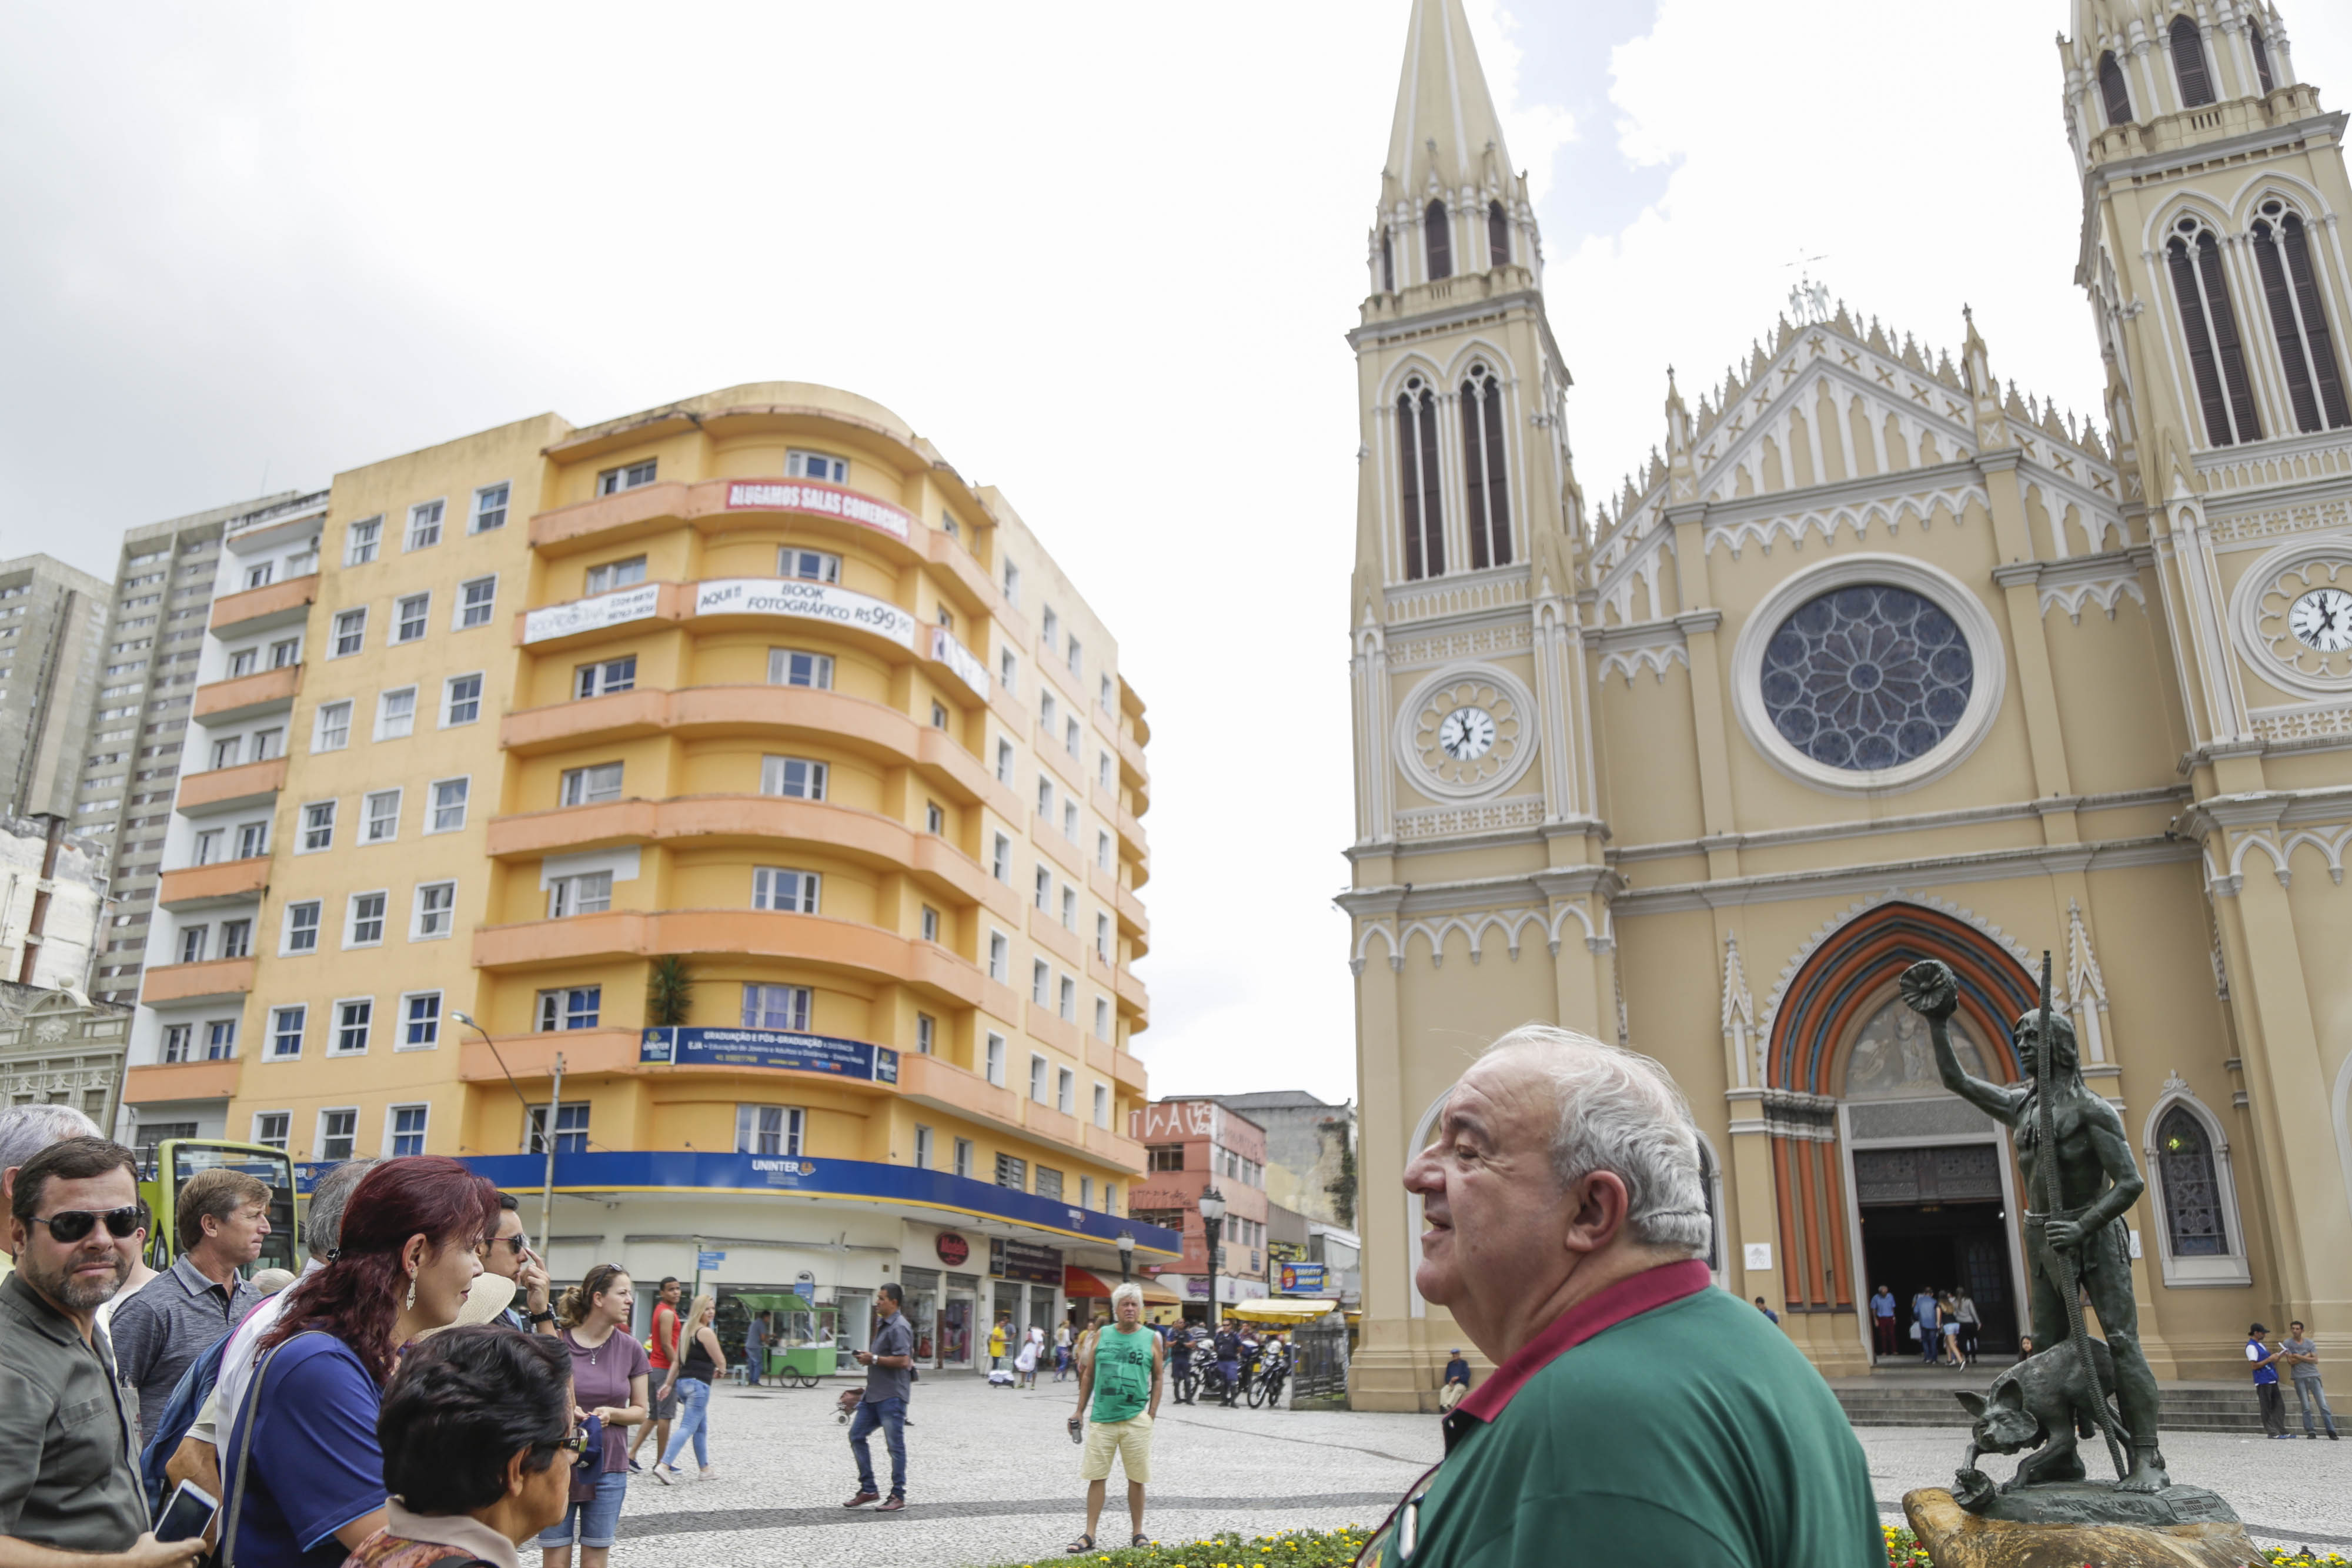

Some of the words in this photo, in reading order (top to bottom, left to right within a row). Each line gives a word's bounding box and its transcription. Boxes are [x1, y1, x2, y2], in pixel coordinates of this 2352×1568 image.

[730, 484, 800, 506] ALUGAMOS
[801, 487, 841, 513] SALAS
[782, 583, 826, 599] BOOK
[747, 596, 850, 620] FOTOGRÁFICO
[703, 1031, 751, 1042] GRADUAÇÃO
[687, 1041, 703, 1050] EJA
[752, 1159, 799, 1172] UNINTER
[1128, 1352, 1144, 1366] 92
